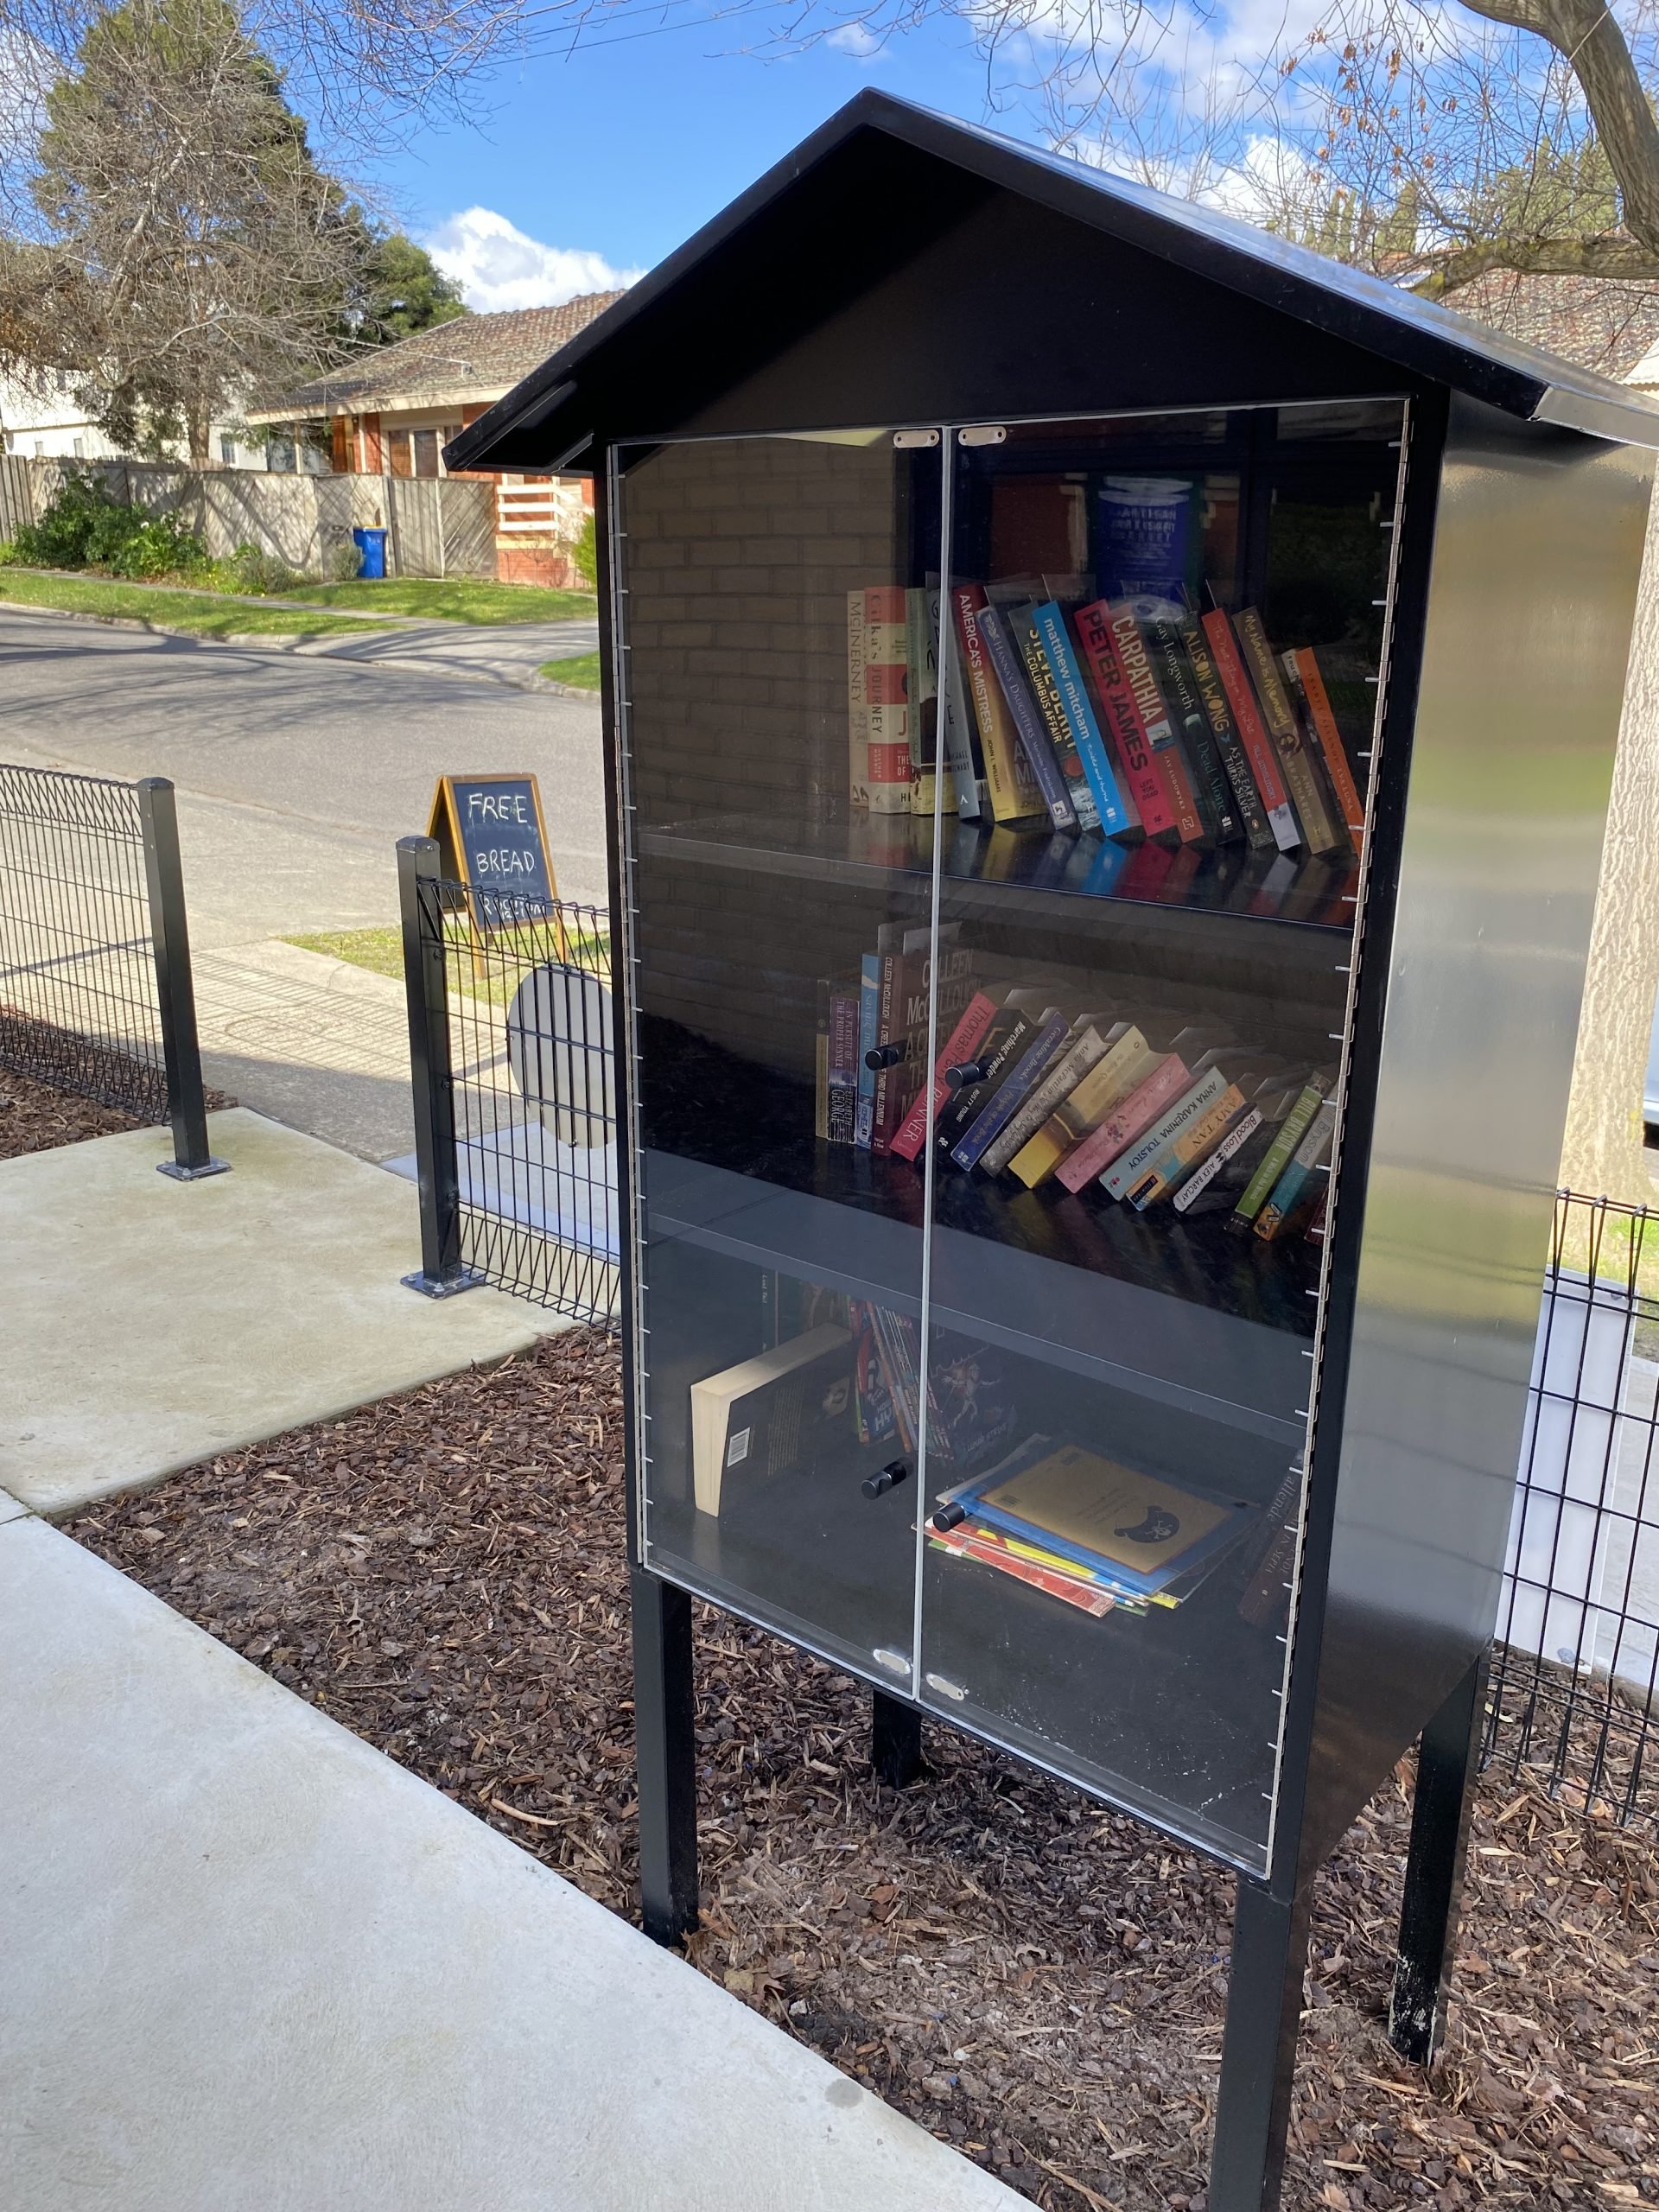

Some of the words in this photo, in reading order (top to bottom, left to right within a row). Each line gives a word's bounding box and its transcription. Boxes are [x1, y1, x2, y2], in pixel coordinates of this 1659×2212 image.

[868, 594, 882, 659] Cilka's
[1149, 613, 1173, 642] Gay
[1241, 613, 1257, 632] My
[957, 594, 983, 668] AMERICA'S
[971, 671, 994, 733] MISTRESS
[1023, 643, 1032, 657] THE
[1249, 631, 1270, 666] Name
[1026, 656, 1051, 709] COLUMBUS
[1042, 617, 1074, 679] matthew
[1064, 680, 1093, 740] mitcham
[1110, 614, 1166, 722] CARPATHIA
[1159, 641, 1196, 711] Longworth
[1182, 627, 1214, 682] ALISON
[1199, 682, 1230, 733] WONG
[1261, 667, 1271, 677] is
[869, 667, 883, 734] JOURNEY
[993, 641, 1014, 682] HANNA'S
[1008, 683, 1037, 739] DAUGHTERS
[1082, 609, 1123, 690] PETER
[1109, 690, 1149, 772] JAMES
[1259, 677, 1291, 728] Memory
[1044, 709, 1062, 744] AFFAIR
[986, 739, 995, 756] JOHN
[1163, 754, 1172, 768] JAY
[1229, 745, 1242, 762] AS
[990, 763, 1001, 792] WILLIAMS
[1093, 766, 1103, 781] and
[1196, 741, 1217, 774] Dead
[1208, 774, 1230, 811] Alone
[1234, 762, 1248, 779] THE
[1300, 773, 1313, 797] ANN
[1167, 770, 1185, 810] LUDOWYKE
[1224, 758, 1241, 786] TURNS
[1234, 787, 1252, 818] SILVER
[1240, 778, 1257, 809] EARTH
[1286, 760, 1313, 821] BRASHARES
[1343, 785, 1354, 810] LUNA
[468, 793, 528, 823] FREE
[476, 849, 535, 873] BREAD
[883, 957, 893, 982] COLLEEN
[922, 949, 974, 988] CLLEEN
[906, 977, 982, 1026] McCLLOUGH
[835, 1016, 844, 1040] PROPER
[844, 1020, 853, 1048] PURSUIT
[950, 1004, 990, 1058] Thomas
[999, 1020, 1027, 1055] Marching
[1033, 1025, 1062, 1060] Geraldine
[835, 1043, 843, 1067] SINNER
[844, 1051, 852, 1060] OF
[982, 1052, 1007, 1081] Powder
[1071, 1042, 1091, 1064] Anna
[1017, 1056, 1039, 1082] Brooks
[1046, 1061, 1076, 1096] McPartlin
[830, 1089, 843, 1123] GEORGE
[875, 1091, 884, 1125] MILLENNIUM
[964, 1087, 981, 1107] RUSTY
[1195, 1081, 1218, 1105] ANNA
[1294, 1096, 1317, 1120] BILL
[1158, 1098, 1198, 1141] KARENINA
[1211, 1098, 1238, 1126] AMY
[1190, 1122, 1215, 1148] TAN
[1233, 1114, 1258, 1141] Blood
[1274, 1115, 1306, 1154] BRYSON
[1296, 1119, 1332, 1165] Bryson
[1125, 1135, 1160, 1172] TOLSTOY
[1221, 1134, 1240, 1154] Loss
[1200, 1160, 1217, 1178] ALEX
[1179, 1174, 1205, 1202] BARCLAY
[1266, 1475, 1296, 1522] allende
